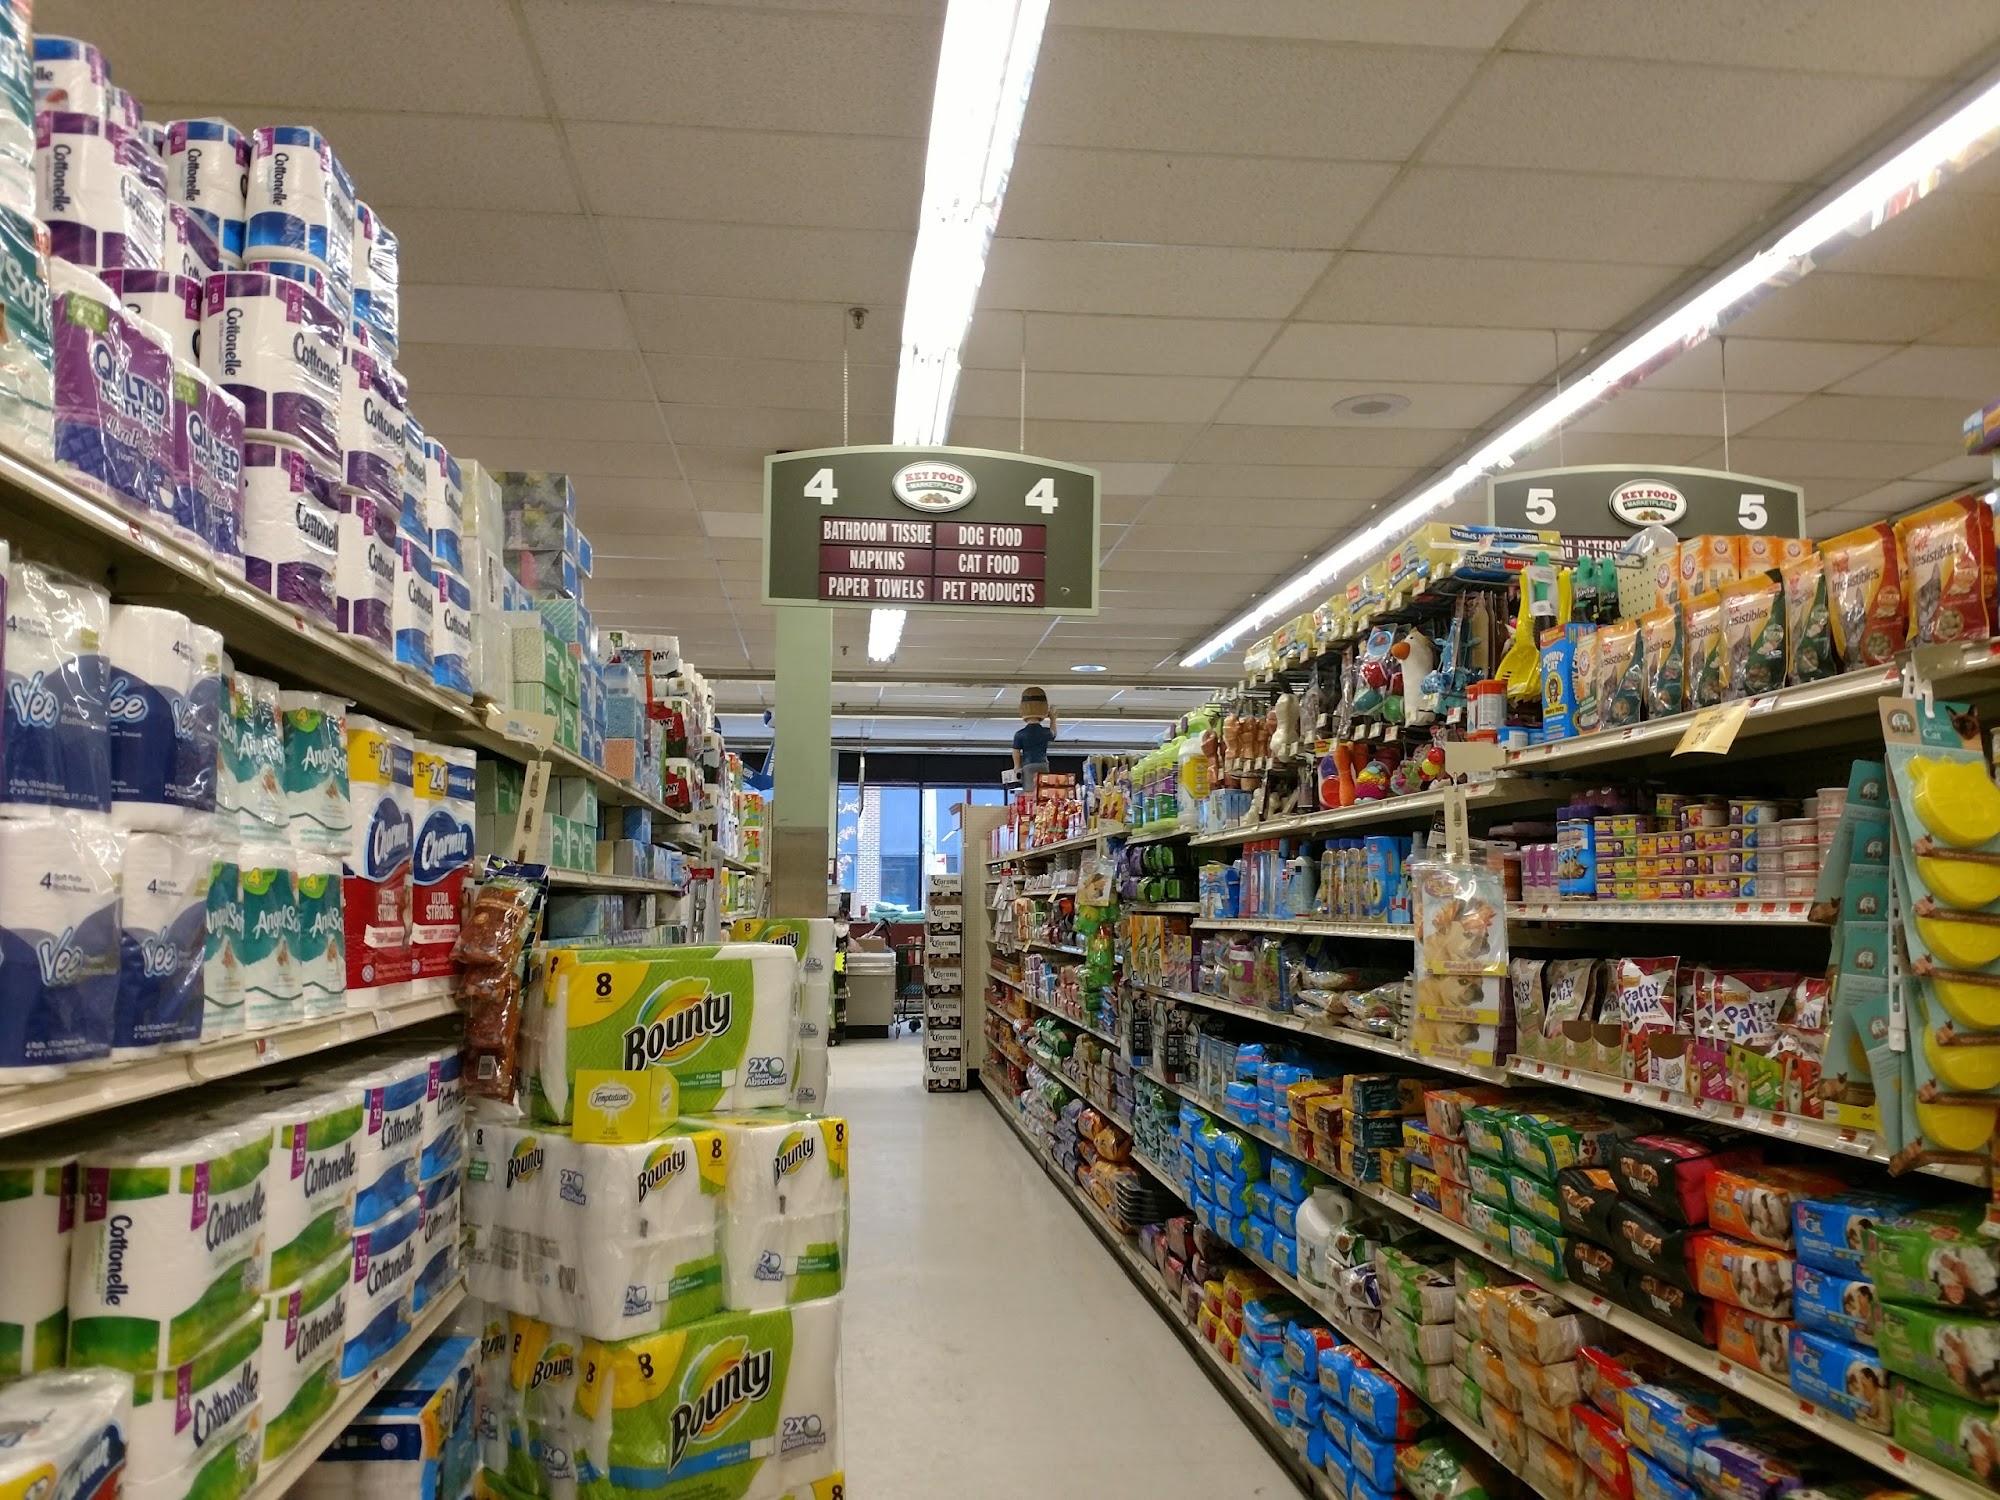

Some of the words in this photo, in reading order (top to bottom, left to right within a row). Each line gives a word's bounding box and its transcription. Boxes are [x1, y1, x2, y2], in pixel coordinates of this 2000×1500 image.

[53, 144, 71, 213] Cottonelle
[185, 148, 202, 202] Cottonelle
[273, 152, 289, 207] Cottonelle
[224, 307, 244, 377] Cottonelle
[803, 468, 839, 505] 4
[905, 472, 929, 481] KEY
[931, 472, 964, 484] FOOD
[1025, 478, 1059, 514] 4
[1525, 488, 1557, 525] 5
[1621, 490, 1644, 500] KEY
[1646, 490, 1677, 501] FOOD
[1737, 494, 1768, 531] 5
[823, 521, 887, 543] BATHROOM
[891, 523, 932, 545] TISSUE
[958, 526, 985, 546] DOG
[989, 527, 1023, 547] FOOD
[849, 550, 905, 571] NAPKINS
[958, 554, 983, 574] CAT
[987, 554, 1020, 575] FOOD
[828, 577, 870, 598] PAPER
[875, 579, 925, 600] TOWELS
[942, 581, 966, 600] PET
[970, 582, 1035, 603] PRODUCTS
[7, 615, 17, 632] 4
[1543, 651, 1565, 668] JONNY
[1547, 661, 1559, 672] CAT
[11, 673, 58, 727] Vee
[1923, 729, 1942, 741] Cat
[430, 763, 448, 791] 24
[374, 811, 409, 866] Charmin
[421, 823, 468, 871] Charmin
[40, 872, 51, 890] 4
[147, 879, 158, 894] 4
[431, 891, 449, 905] ULTRA
[425, 904, 454, 921] STRONG
[744, 922, 751, 932] 8
[38, 928, 82, 986] Vee
[142, 928, 176, 977] Vee
[596, 972, 612, 997] 8
[1624, 982, 1659, 1005] Party
[1629, 999, 1659, 1016] Mix
[623, 992, 732, 1072] Bounty
[749, 1058, 769, 1073] 2X
[430, 1079, 439, 1089] 12
[745, 1075, 787, 1088] Absorbent
[594, 1092, 628, 1104] Temptations
[372, 1107, 382, 1120] 12
[382, 1103, 424, 1150] Cottonelle
[476, 1129, 483, 1145] 8
[835, 1123, 844, 1142] 8
[295, 1147, 305, 1162] 12
[711, 1138, 722, 1159] 8
[304, 1141, 357, 1199] Cottonelle
[506, 1147, 544, 1192] Bounty
[637, 1148, 686, 1203] Bounty
[88, 1192, 102, 1207] 12
[206, 1181, 266, 1252] Cottonelle
[106, 1214, 133, 1306] Cottonelle
[358, 1255, 368, 1268] 12
[367, 1242, 415, 1297] Cottonelle
[296, 1293, 346, 1364] Cottonelle
[585, 1361, 596, 1384] 8
[637, 1352, 654, 1379] 8
[193, 1360, 259, 1448] Cottonelle
[668, 1348, 773, 1475] Bounty
[783, 1417, 806, 1438] 2X
[781, 1433, 826, 1453] Absorbent
